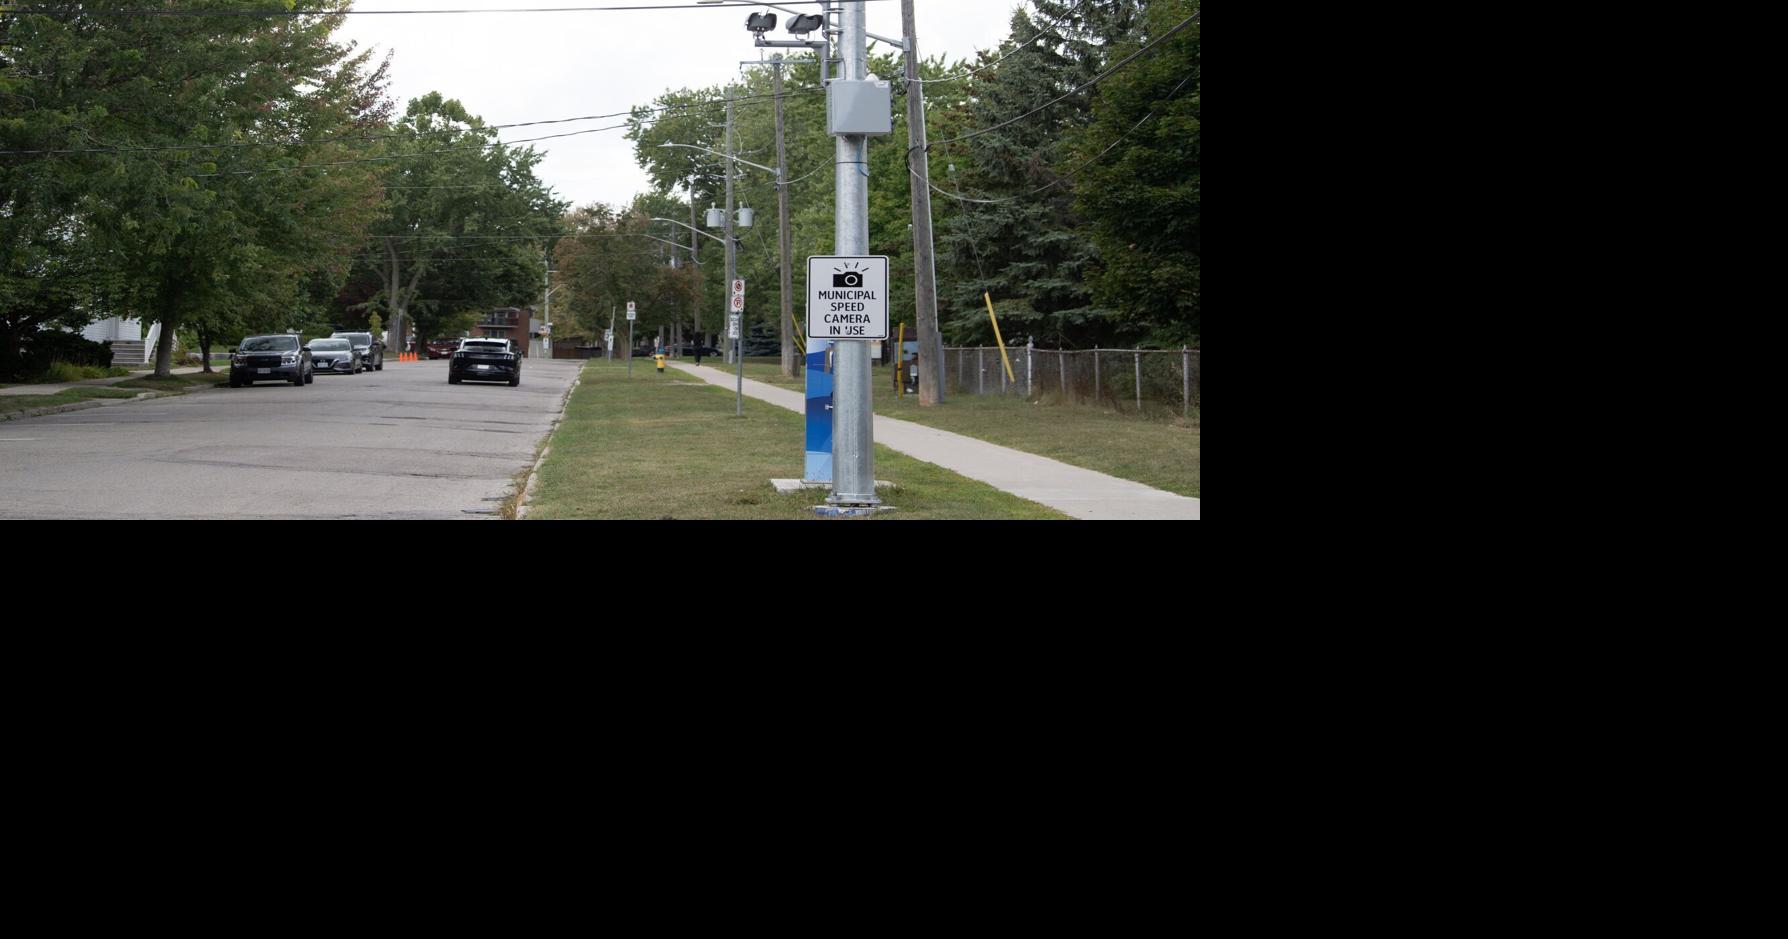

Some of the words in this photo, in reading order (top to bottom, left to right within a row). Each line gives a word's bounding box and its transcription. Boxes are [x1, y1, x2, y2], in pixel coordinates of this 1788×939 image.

[818, 290, 877, 300] MUNICIPAL
[830, 302, 865, 312] SPEED
[824, 314, 871, 324] CAMERA
[829, 326, 841, 335] IN
[845, 325, 865, 335] USE
